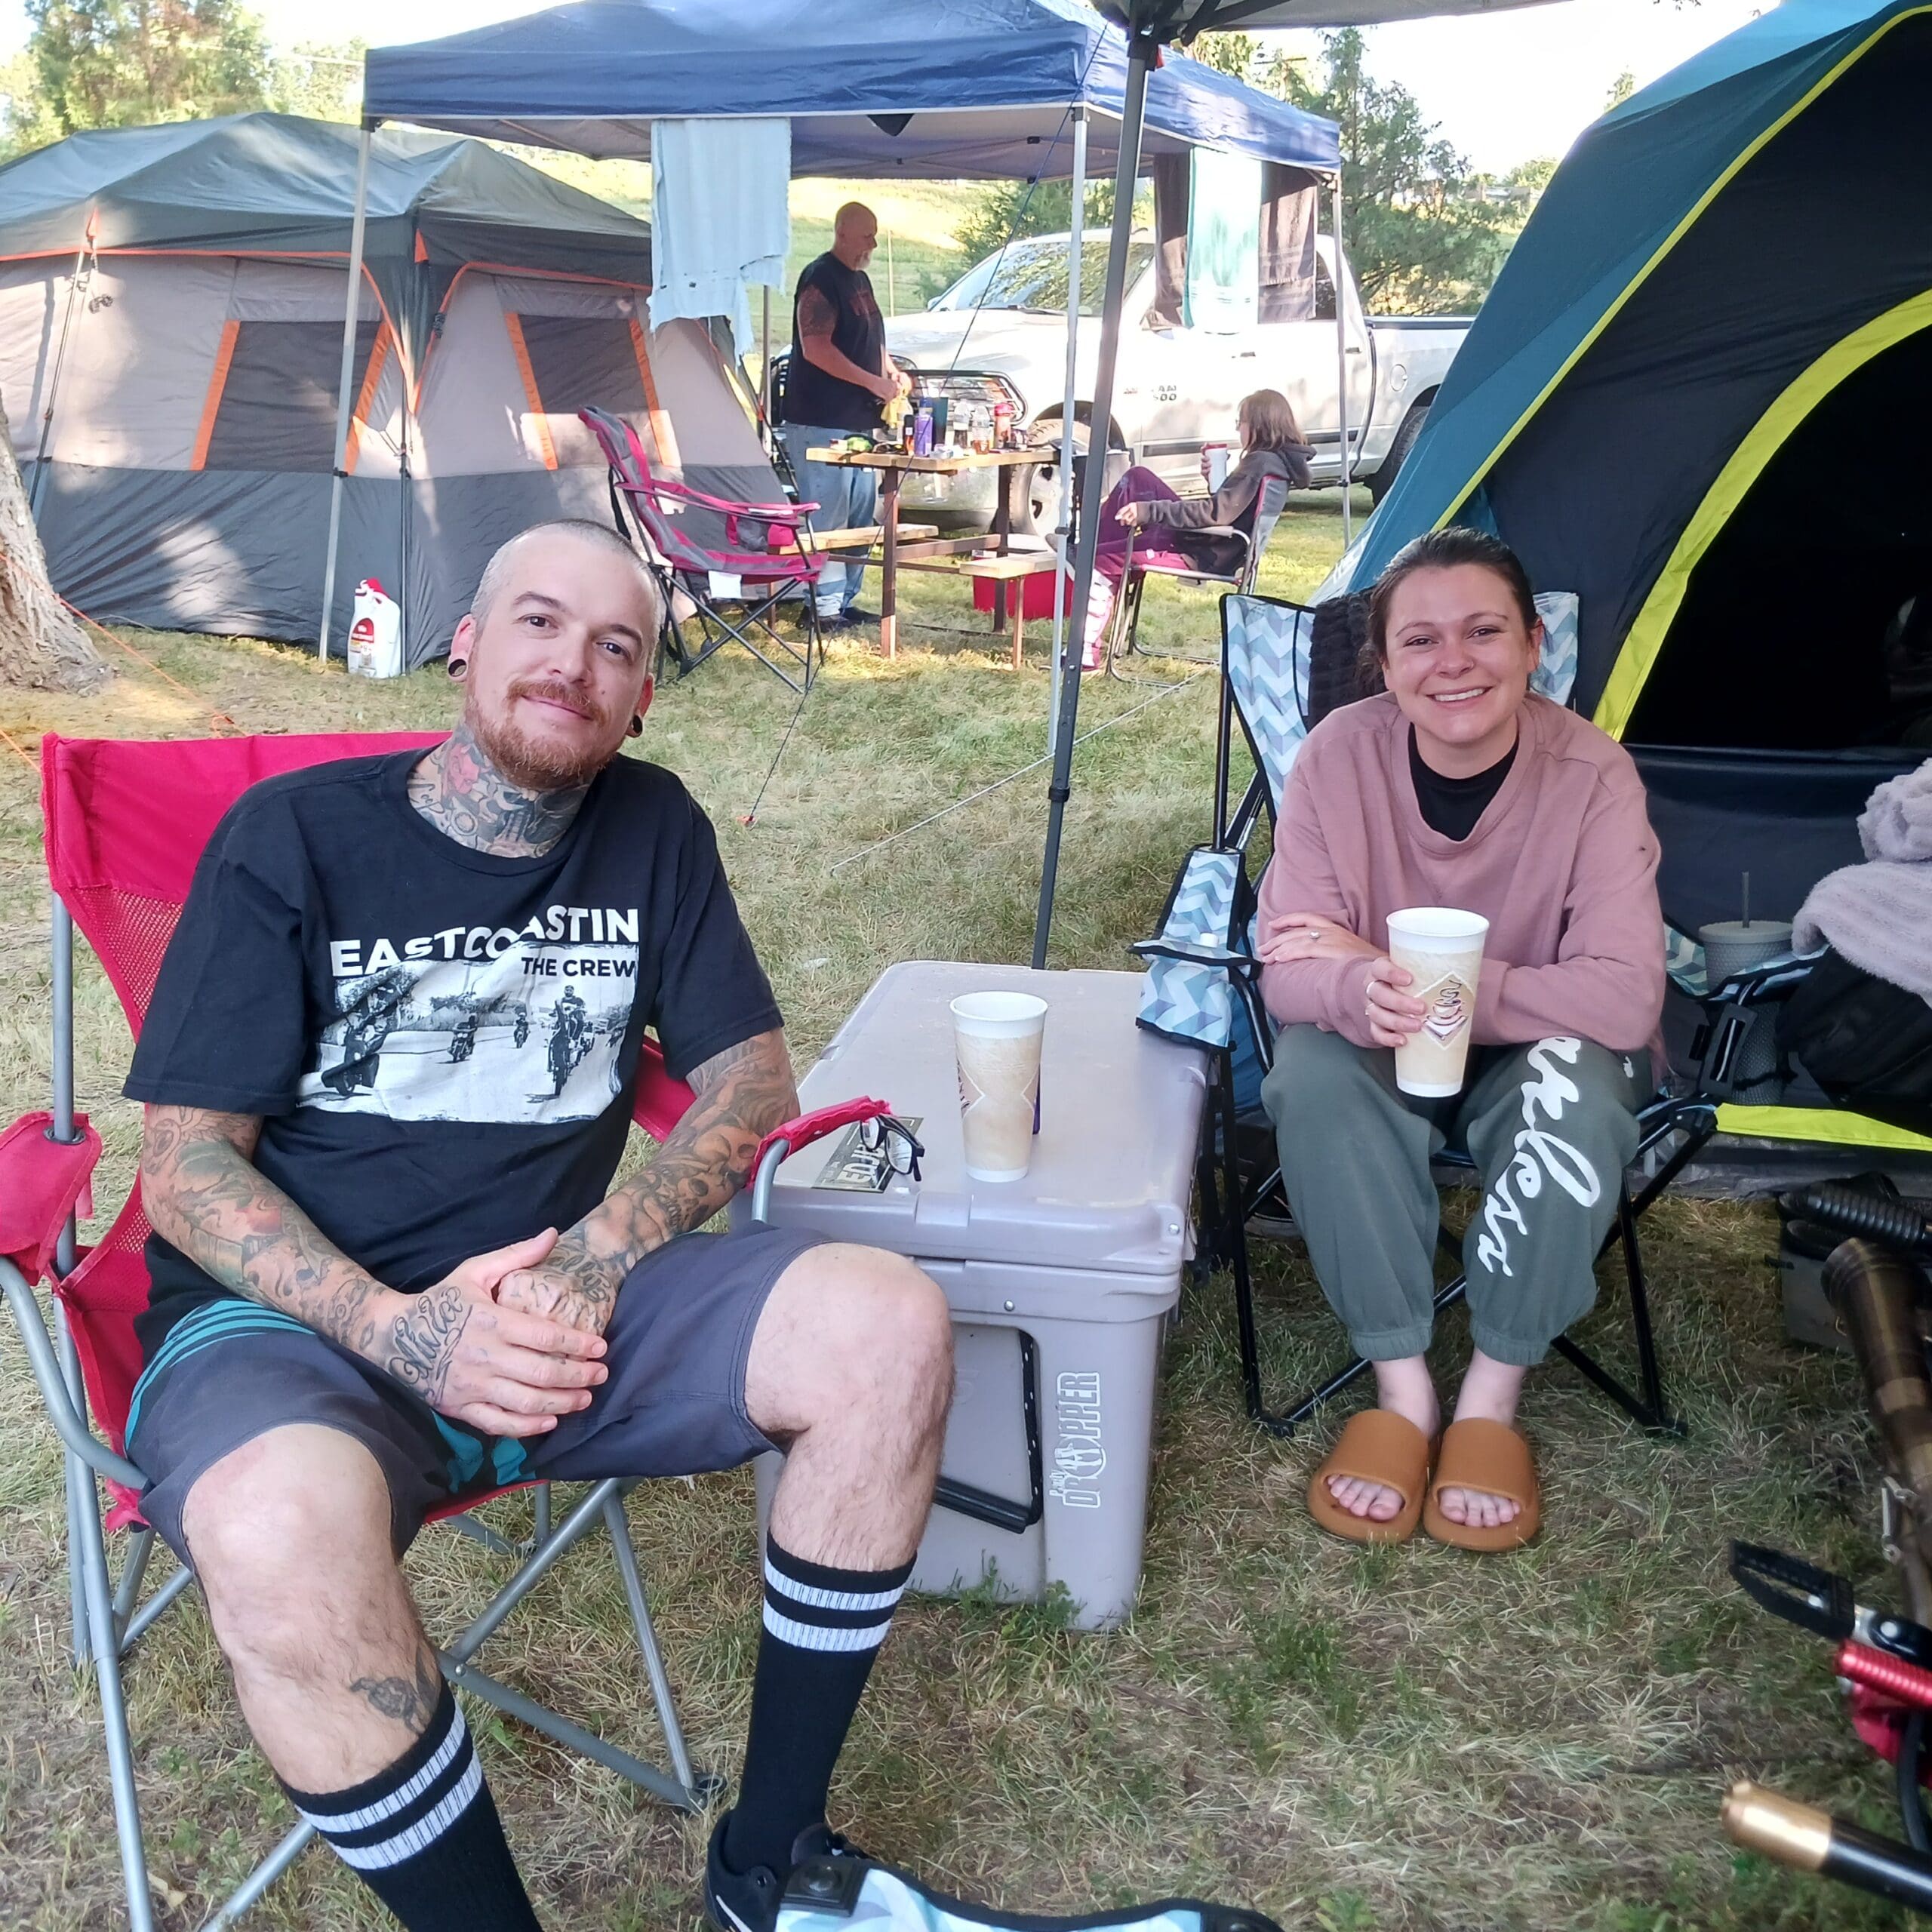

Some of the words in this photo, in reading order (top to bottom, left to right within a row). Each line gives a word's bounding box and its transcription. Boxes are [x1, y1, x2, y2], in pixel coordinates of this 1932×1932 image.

[329, 904, 640, 977] EASTCOASTIN
[521, 956, 556, 976] THE
[563, 958, 636, 978] CREW
